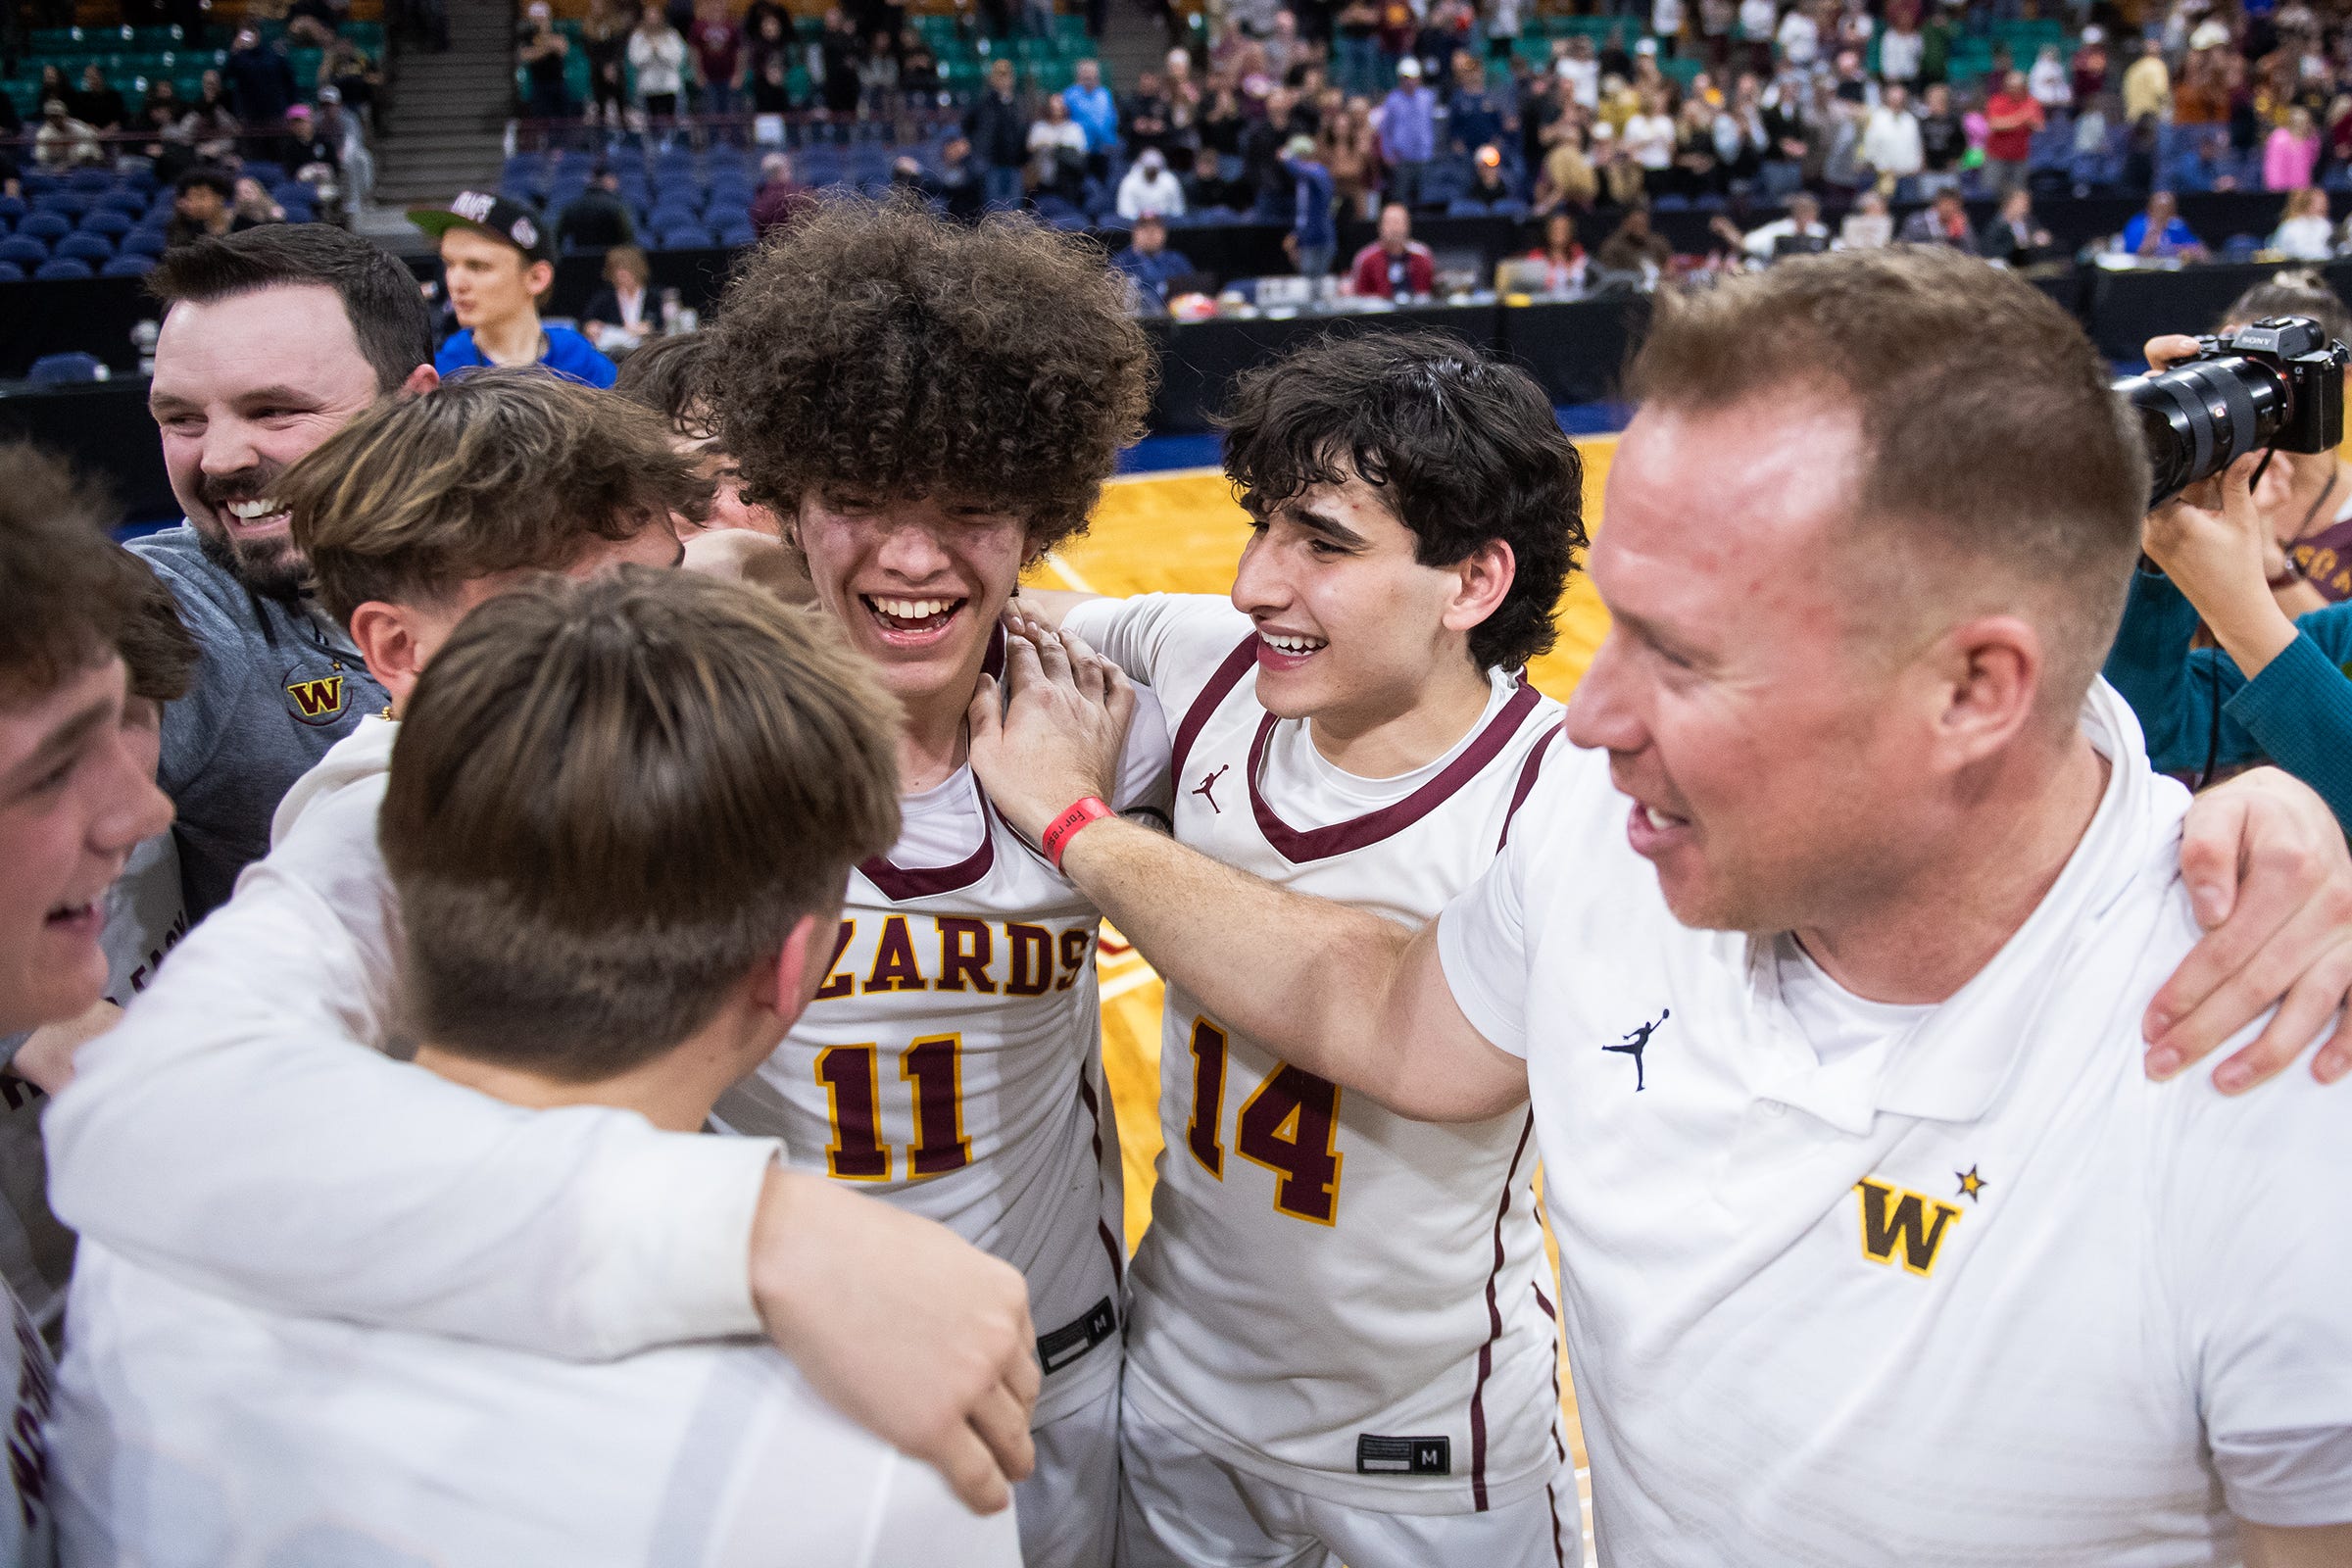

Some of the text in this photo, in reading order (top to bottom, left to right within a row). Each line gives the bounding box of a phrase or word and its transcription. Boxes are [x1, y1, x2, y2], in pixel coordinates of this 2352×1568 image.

[2241, 336, 2272, 346] SONY
[287, 676, 343, 716] W
[1065, 809, 1087, 828] For
[814, 1032, 972, 1182] 11
[1186, 1014, 1344, 1228] 14
[1851, 1176, 1964, 1279] W
[1094, 1314, 1107, 1333] M
[1421, 1449, 1438, 1465] M
